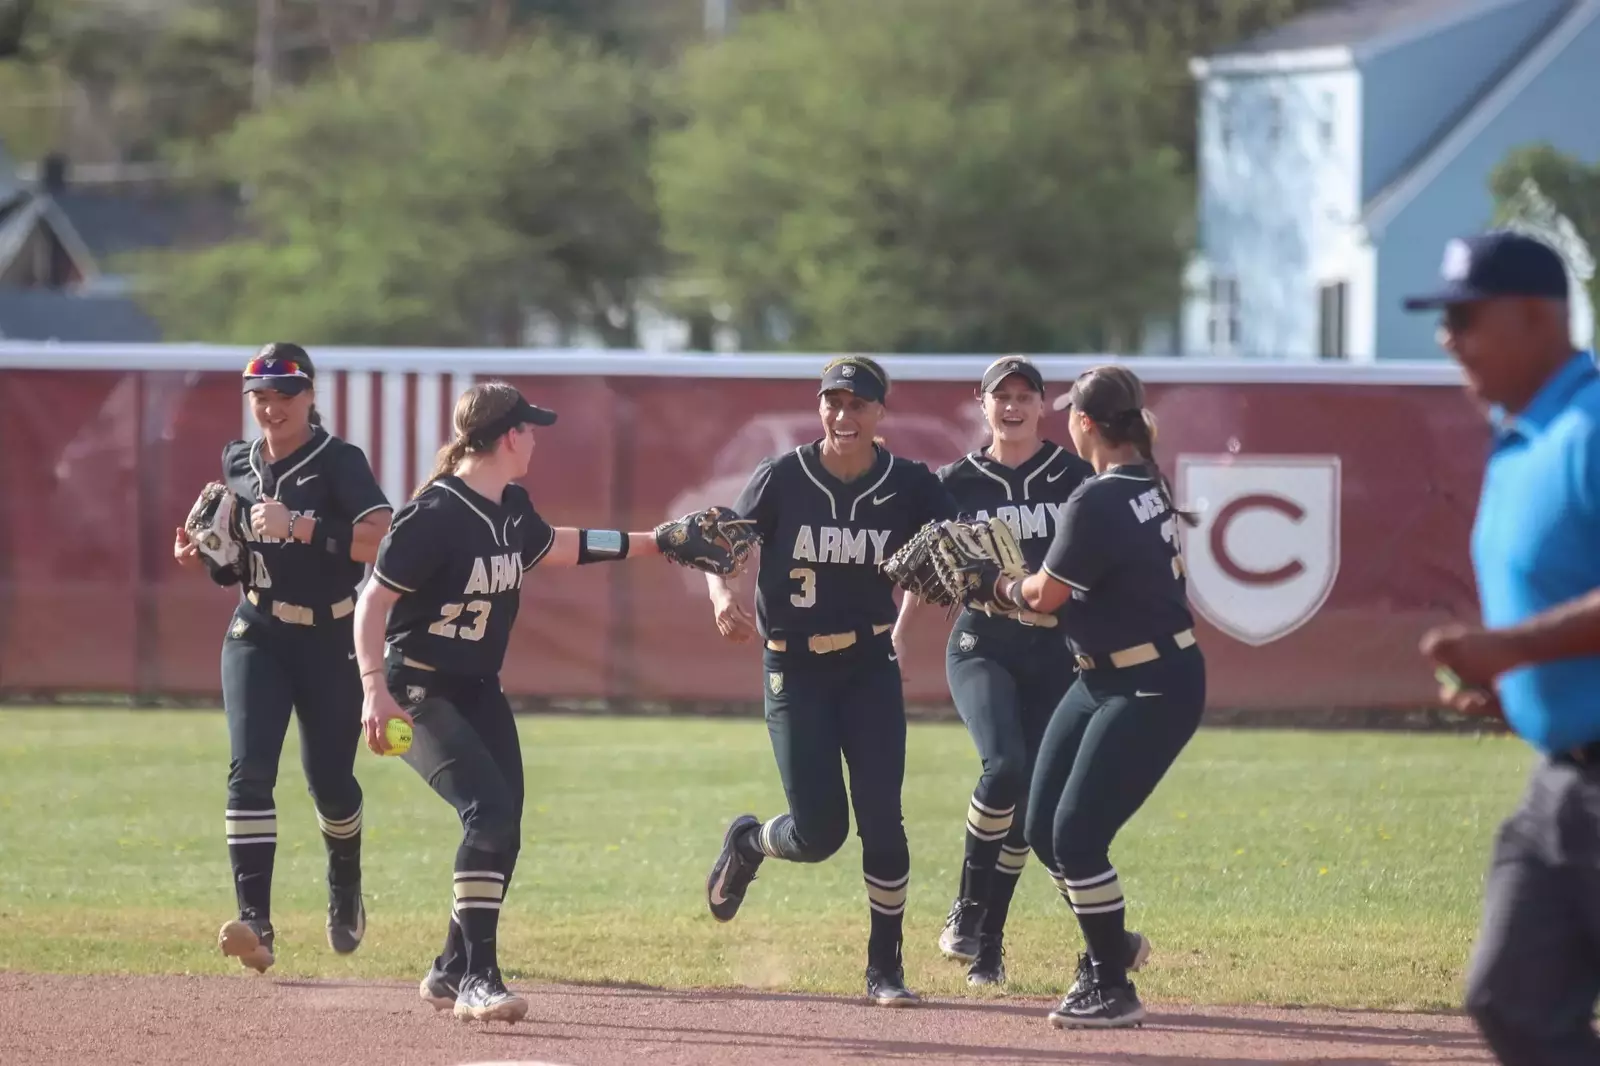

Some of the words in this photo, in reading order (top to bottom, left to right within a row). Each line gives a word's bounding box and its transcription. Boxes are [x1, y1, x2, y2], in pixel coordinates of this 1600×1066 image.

[792, 524, 892, 565] ARMY
[1208, 492, 1304, 588] C
[789, 567, 816, 608] 3
[427, 599, 492, 642] 23
